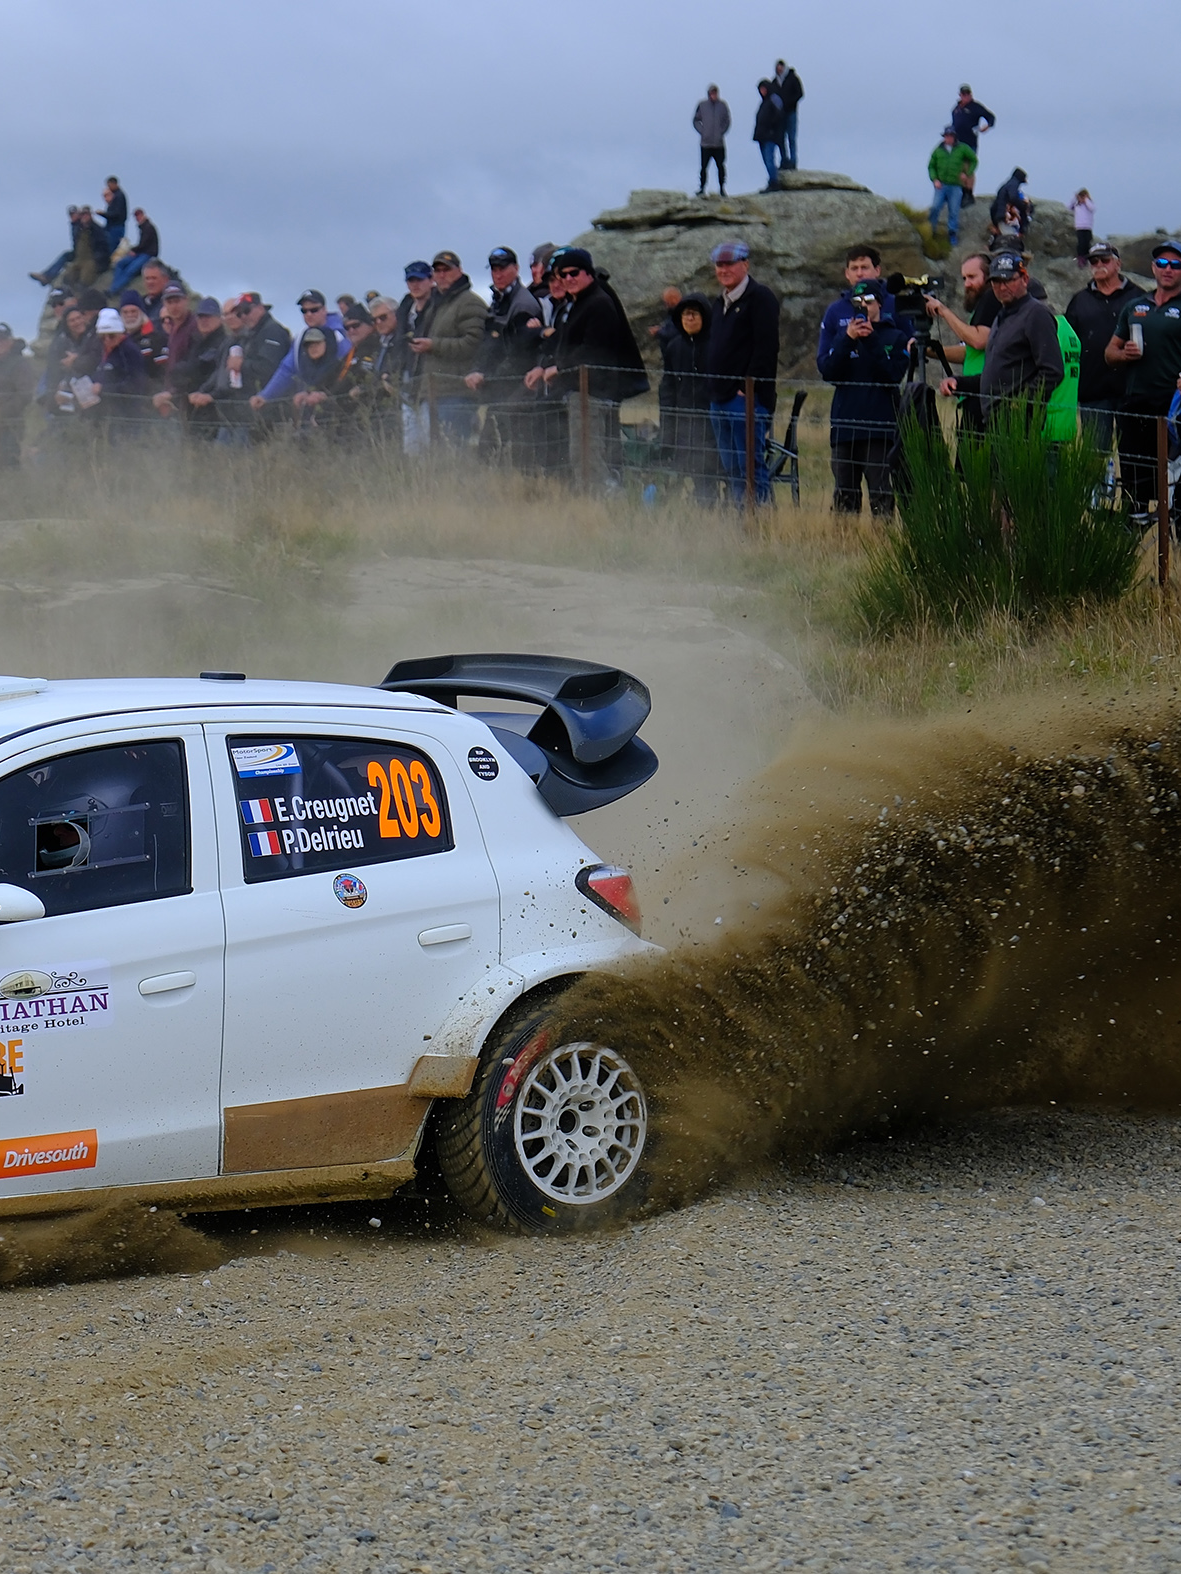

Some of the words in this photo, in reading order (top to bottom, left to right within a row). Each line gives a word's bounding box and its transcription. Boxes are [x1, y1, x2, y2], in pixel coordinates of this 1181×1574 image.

[274, 790, 379, 823] E.Creugnet
[367, 758, 442, 838] 203
[281, 825, 365, 854] P.Delrieu
[44, 1015, 86, 1030] Hotel
[3, 1141, 89, 1169] Drivesouth
